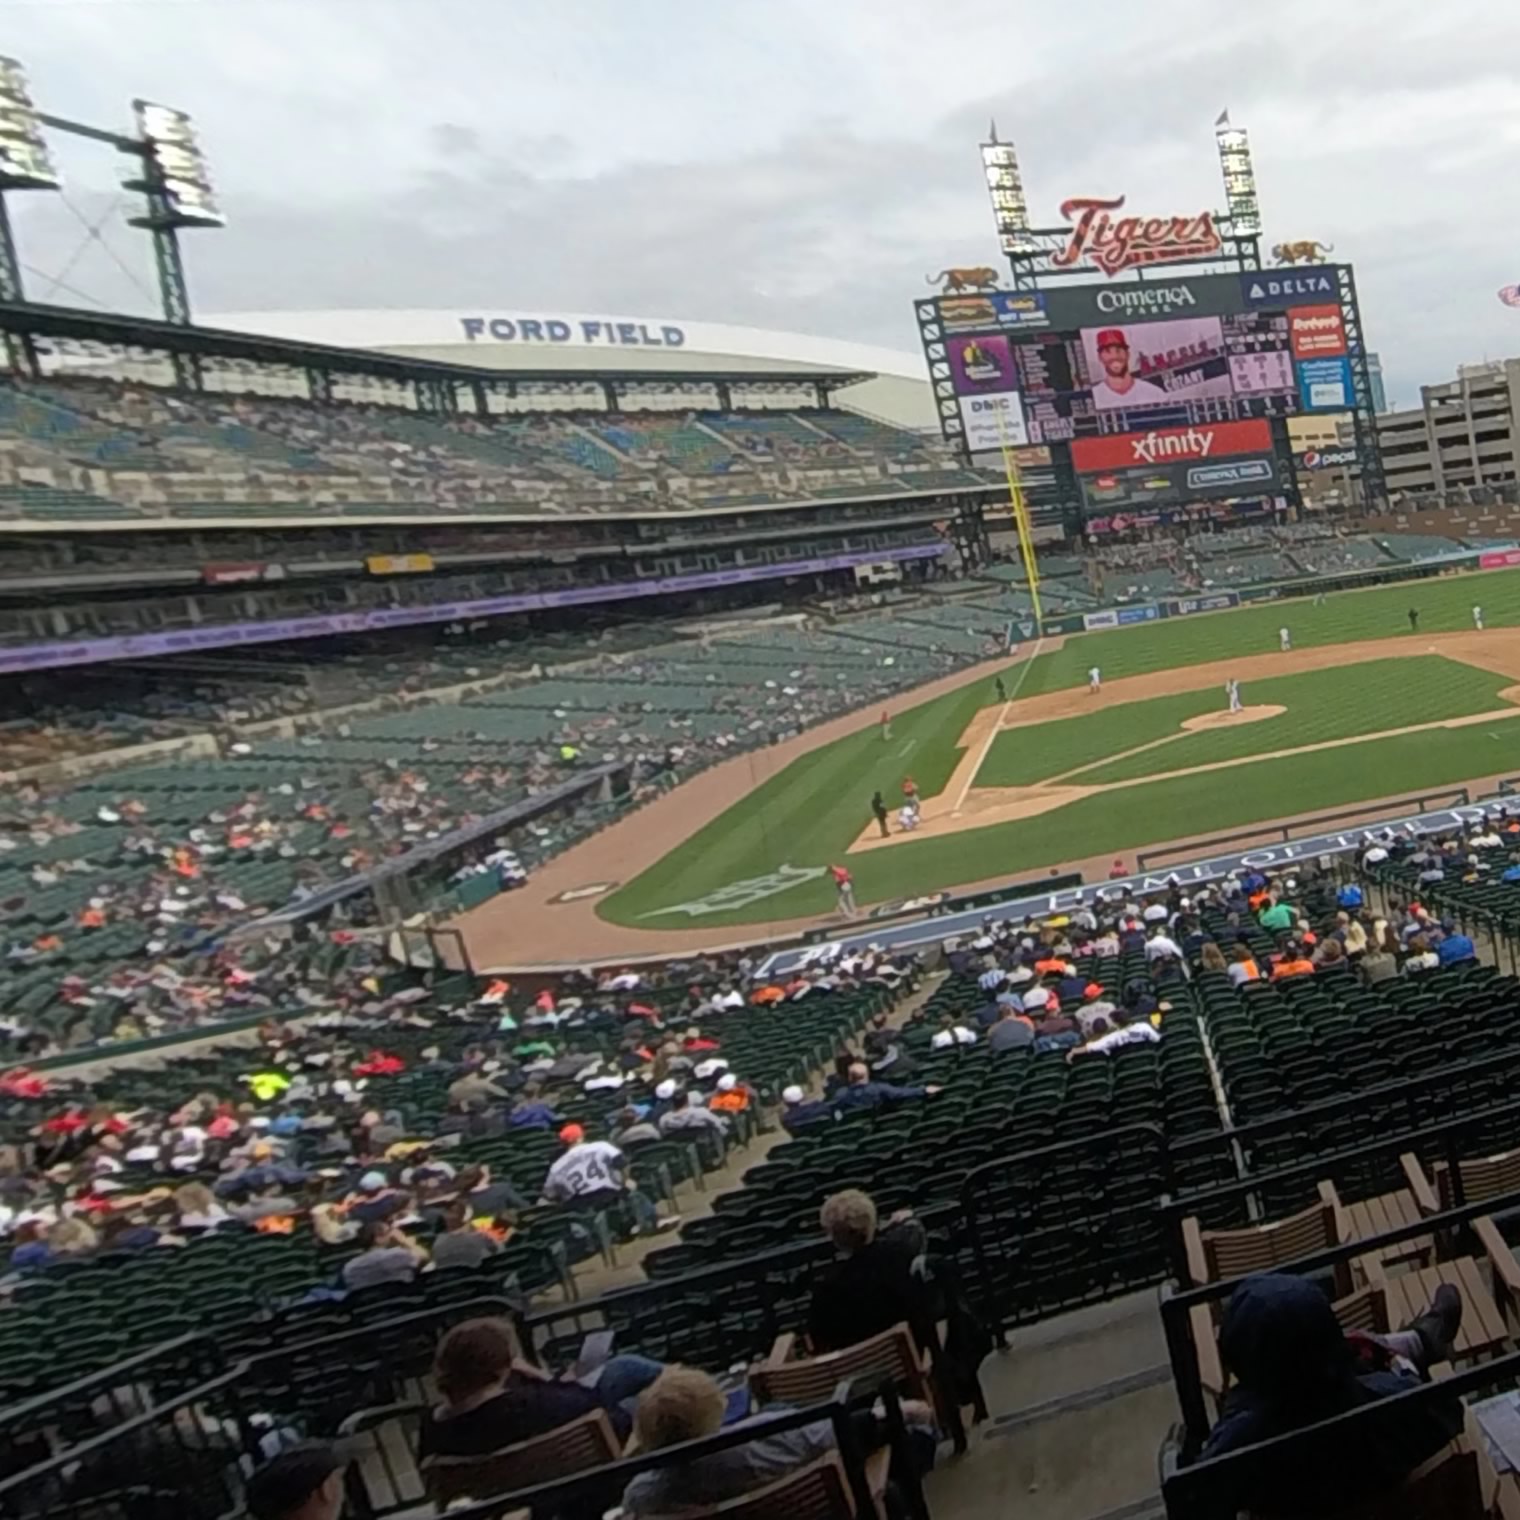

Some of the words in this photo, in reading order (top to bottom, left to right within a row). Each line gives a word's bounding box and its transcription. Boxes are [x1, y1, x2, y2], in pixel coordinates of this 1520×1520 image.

[1052, 195, 1221, 271] Tigers
[1097, 285, 1196, 312] Comerica
[1267, 277, 1331, 295] DELTA
[1126, 306, 1172, 316] PARK
[460, 318, 572, 342] FORD
[578, 320, 685, 347] FIELD
[1131, 428, 1214, 463] xfinity
[1322, 450, 1357, 465] pepsi
[566, 1160, 606, 1191] 24
